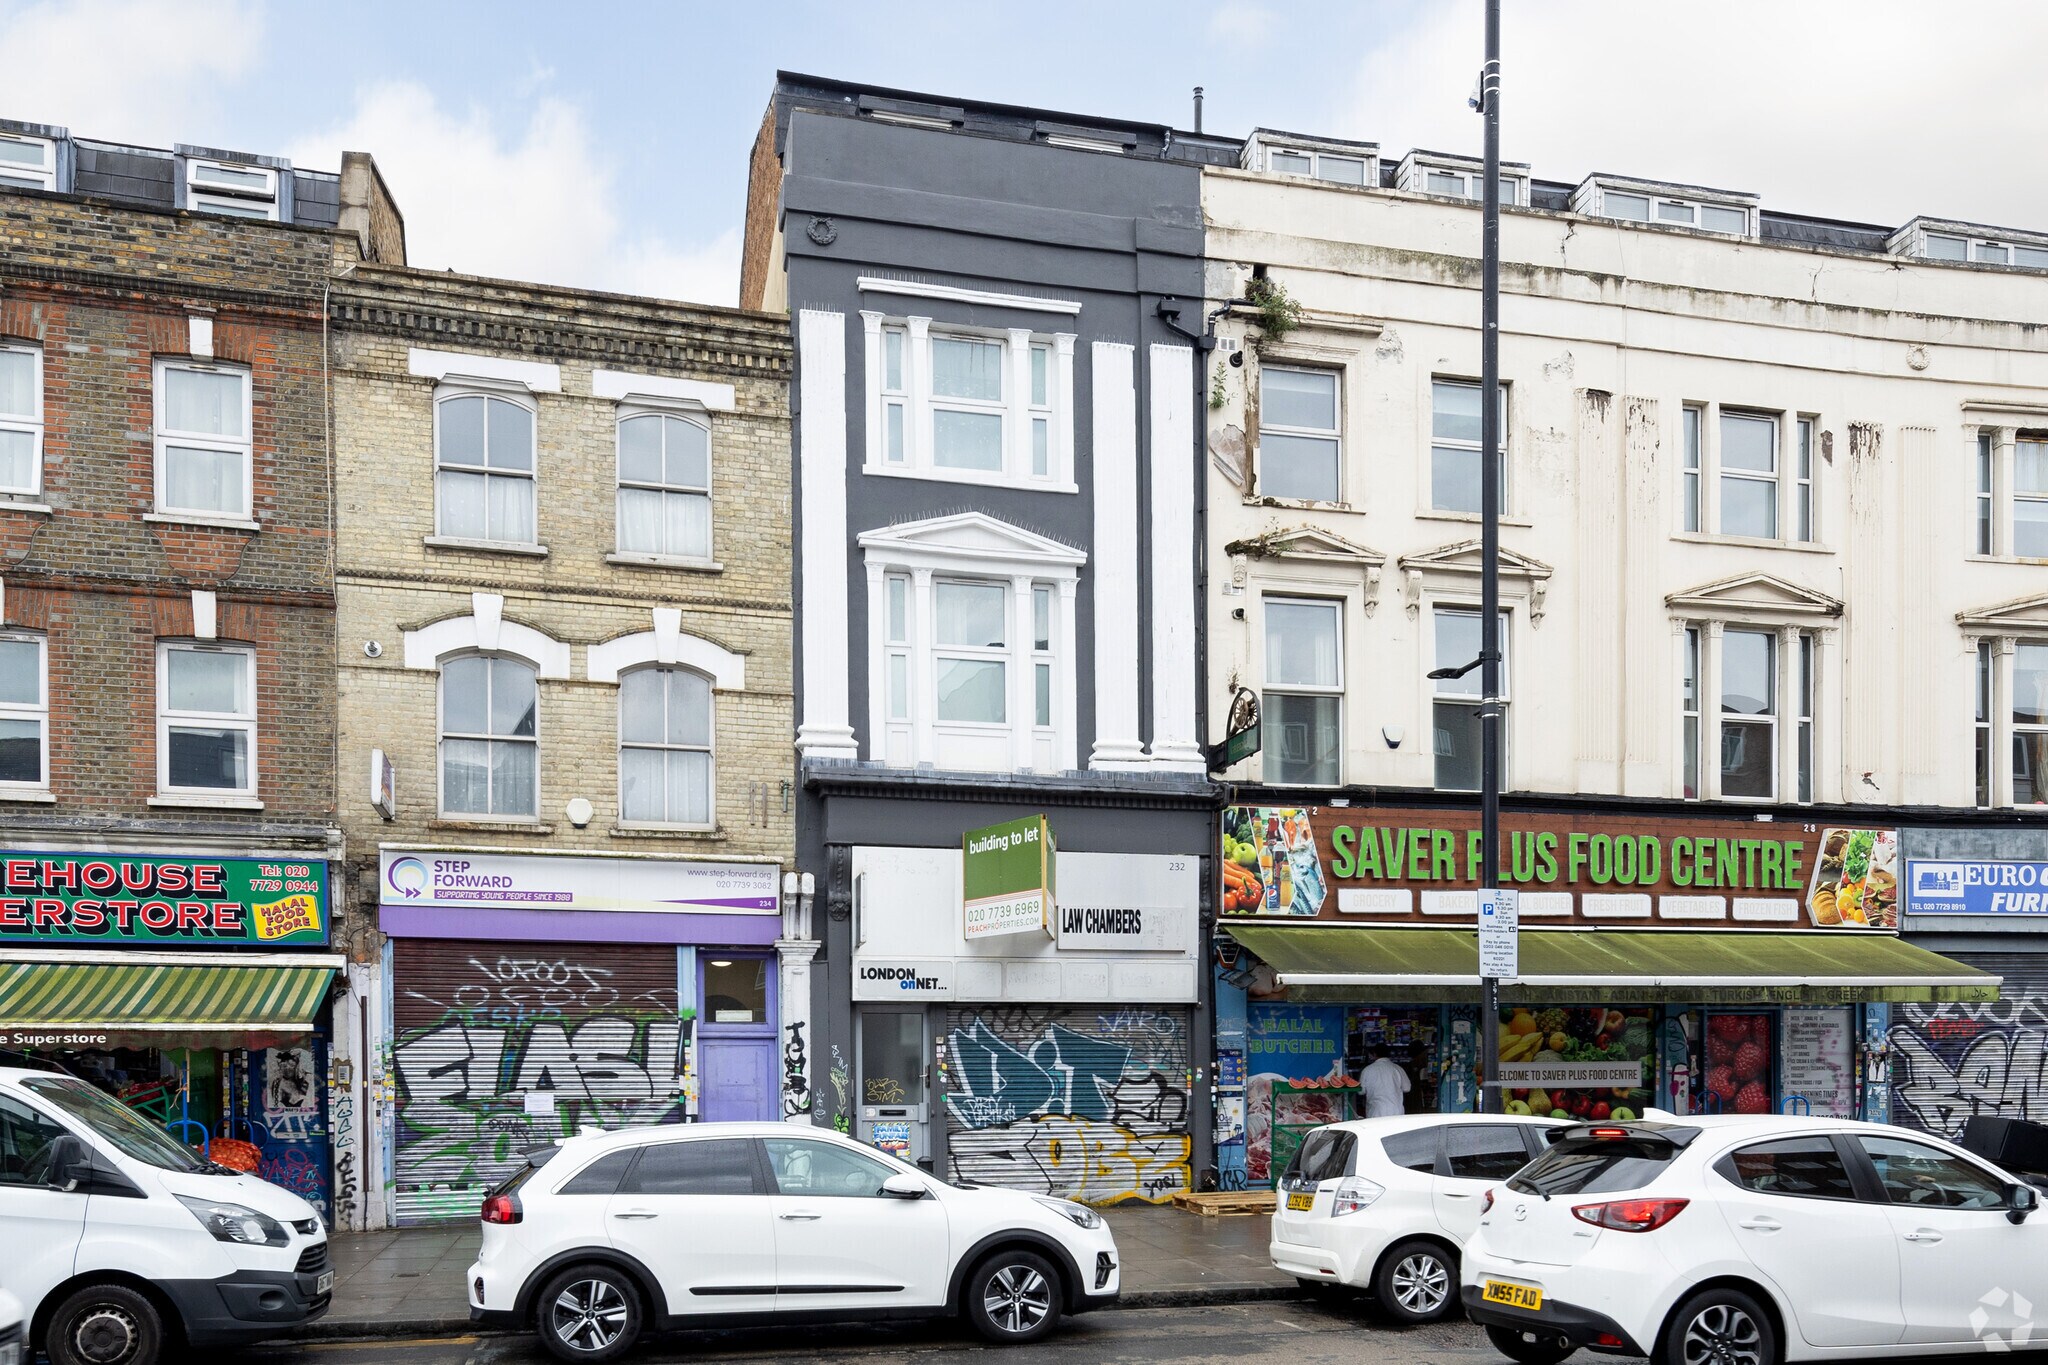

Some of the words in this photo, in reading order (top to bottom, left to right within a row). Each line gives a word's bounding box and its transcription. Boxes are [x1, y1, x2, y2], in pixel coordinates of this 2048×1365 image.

[969, 834, 1009, 855] building
[1010, 831, 1022, 845] to
[1024, 826, 1039, 843] let
[1331, 825, 1457, 881] SAVER
[1568, 832, 1661, 885] FOOD
[1671, 835, 1804, 889] CENTRE
[258, 864, 283, 877] Tel:
[285, 865, 310, 878] 020
[434, 860, 471, 873] STEP
[1169, 862, 1186, 872] 232
[434, 874, 513, 888] FORWARD
[687, 869, 772, 880] www.step-forward.org
[1964, 864, 2037, 887] EURO
[250, 879, 283, 892] 7729
[285, 880, 319, 892] 0944
[716, 880, 731, 889] 020
[733, 881, 751, 889] 7739
[753, 882, 772, 890] 3082
[436, 890, 480, 899] SUPPORTING
[481, 891, 505, 900] YOUNG
[505, 892, 532, 901] PEOPLE
[533, 893, 553, 901] SINCE
[1353, 894, 1397, 908] GROCERY
[1439, 896, 1476, 909] BAKERY
[261, 896, 309, 918] HALAL
[759, 899, 772, 907] 234
[1485, 905, 1492, 915] P
[1532, 897, 1571, 910] BUTCHER
[1588, 899, 1617, 912] FRESH
[1619, 899, 1644, 912] FRUIT
[1666, 900, 1720, 914] VEGETABLES
[1739, 902, 1773, 915] FROZEN
[1774, 902, 1793, 916] FISH
[1911, 902, 1923, 910] TEL
[1923, 902, 1935, 911] 020
[1936, 903, 1951, 911] 7729
[266, 908, 306, 927] FOOD
[968, 908, 985, 922] 020
[988, 905, 1012, 920] 7739
[1014, 900, 1039, 916] 6969
[265, 916, 311, 937] STORE
[1063, 908, 1084, 933] LAW
[1085, 908, 1142, 935] CHAMBERS
[860, 967, 915, 980] LONDON
[1826, 989, 1864, 1001] GREEK
[1264, 1018, 1324, 1033] HALAL
[13, 1032, 107, 1047] Superstore
[1251, 1039, 1336, 1054] BUTCHER
[1499, 1070, 1529, 1081] ELCOME
[1531, 1070, 1540, 1081] TO
[1542, 1070, 1566, 1081] SAVER
[1568, 1069, 1587, 1080] PLUS
[1589, 1069, 1607, 1080] FOOD
[1609, 1069, 1638, 1080] CENTRE
[1514, 1288, 1537, 1306] FAD
